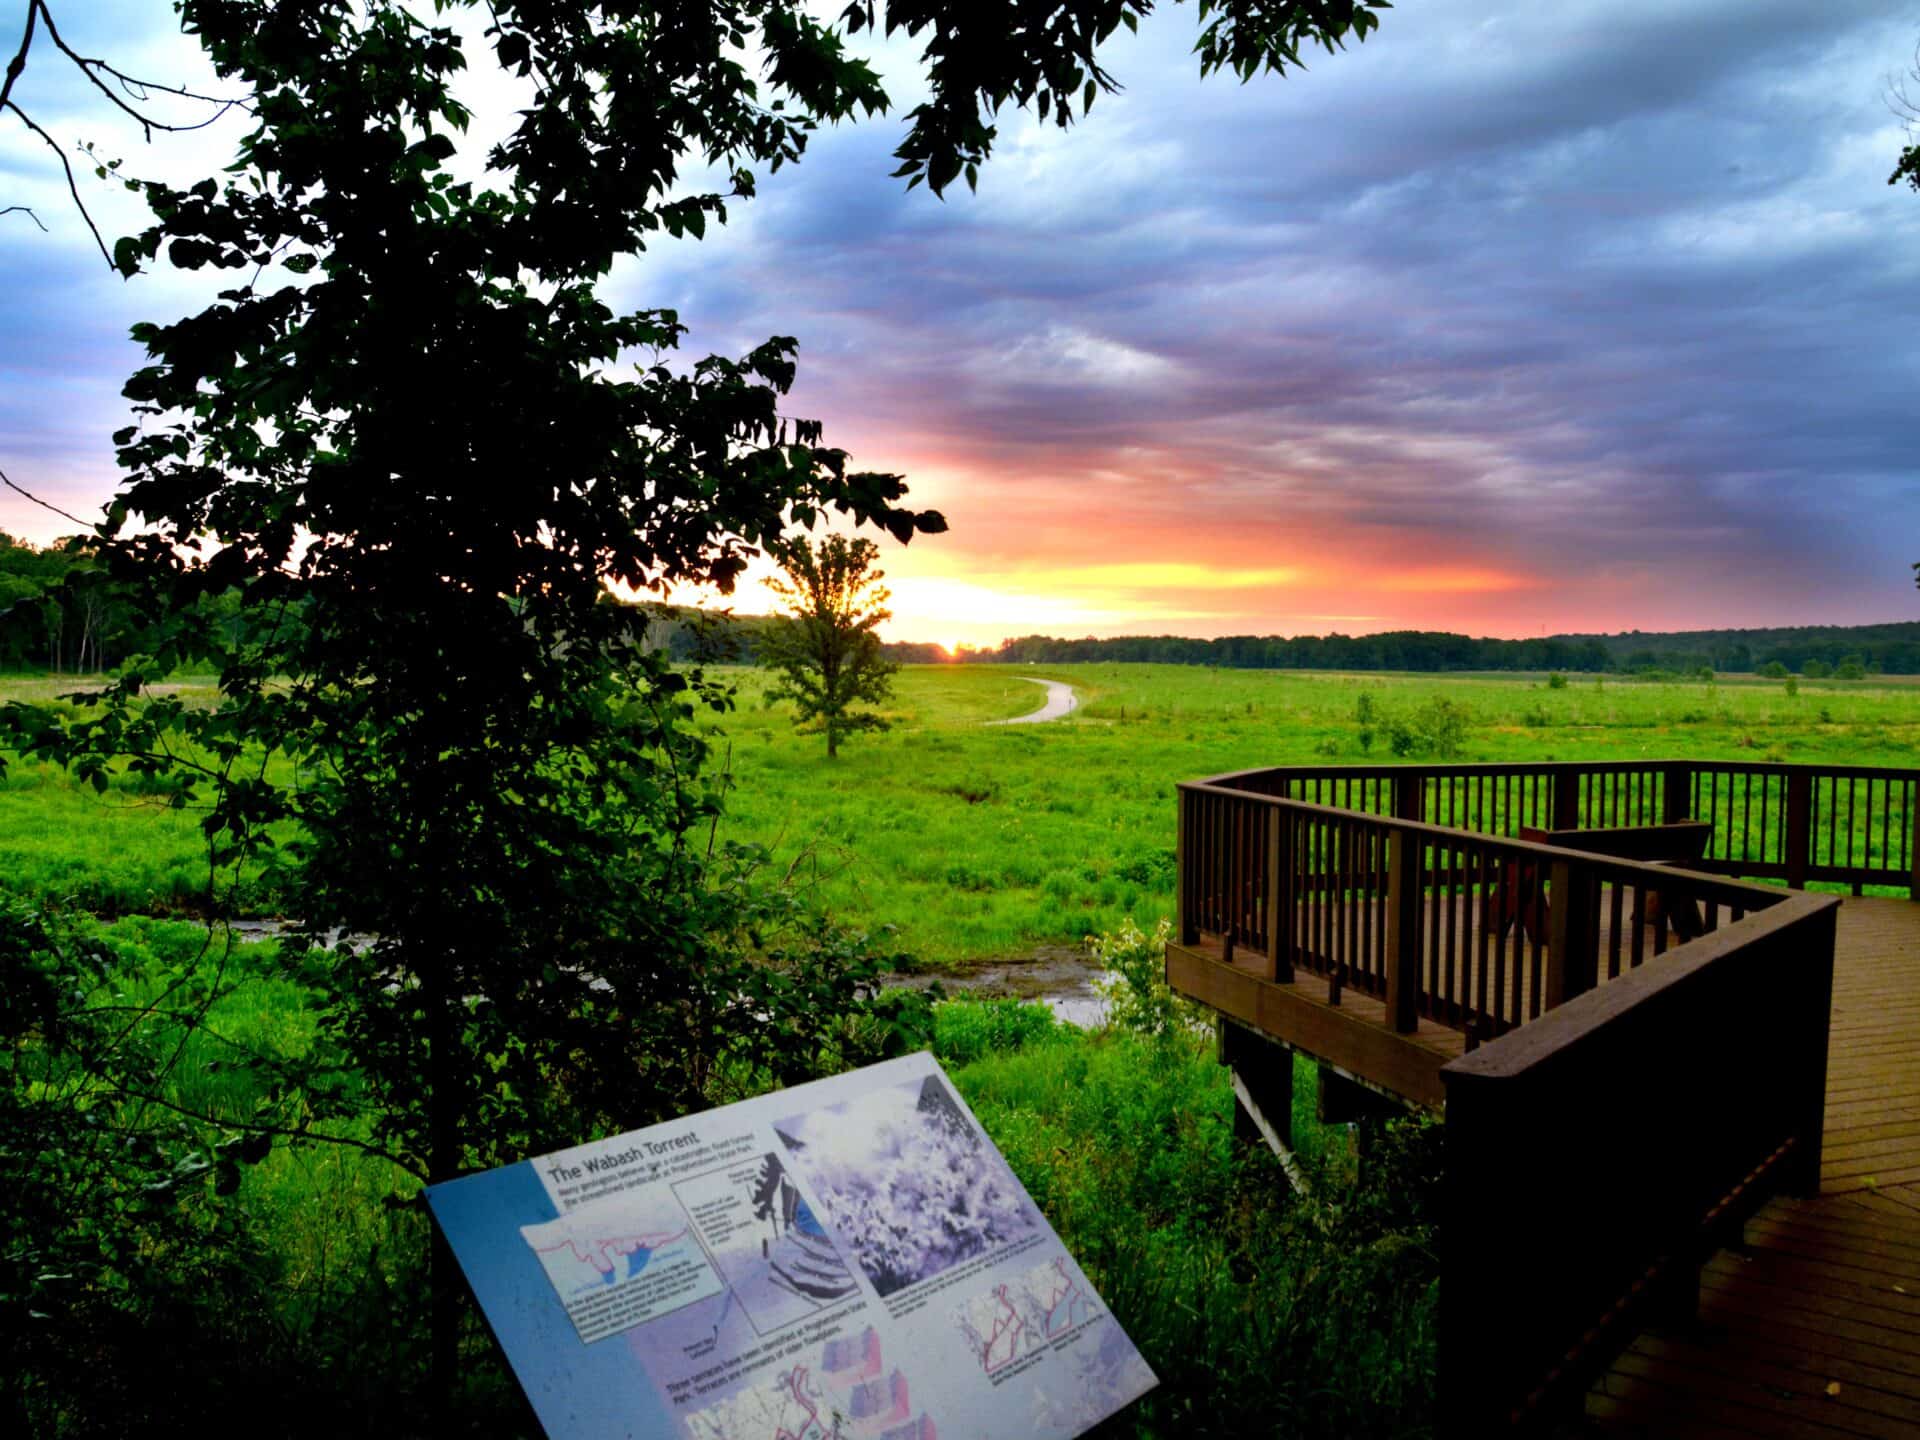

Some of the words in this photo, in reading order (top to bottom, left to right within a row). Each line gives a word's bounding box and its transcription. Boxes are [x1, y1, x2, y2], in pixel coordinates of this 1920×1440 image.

[547, 1166, 582, 1183] The
[582, 1147, 644, 1173] Wabash
[642, 1131, 701, 1156] Torrent
